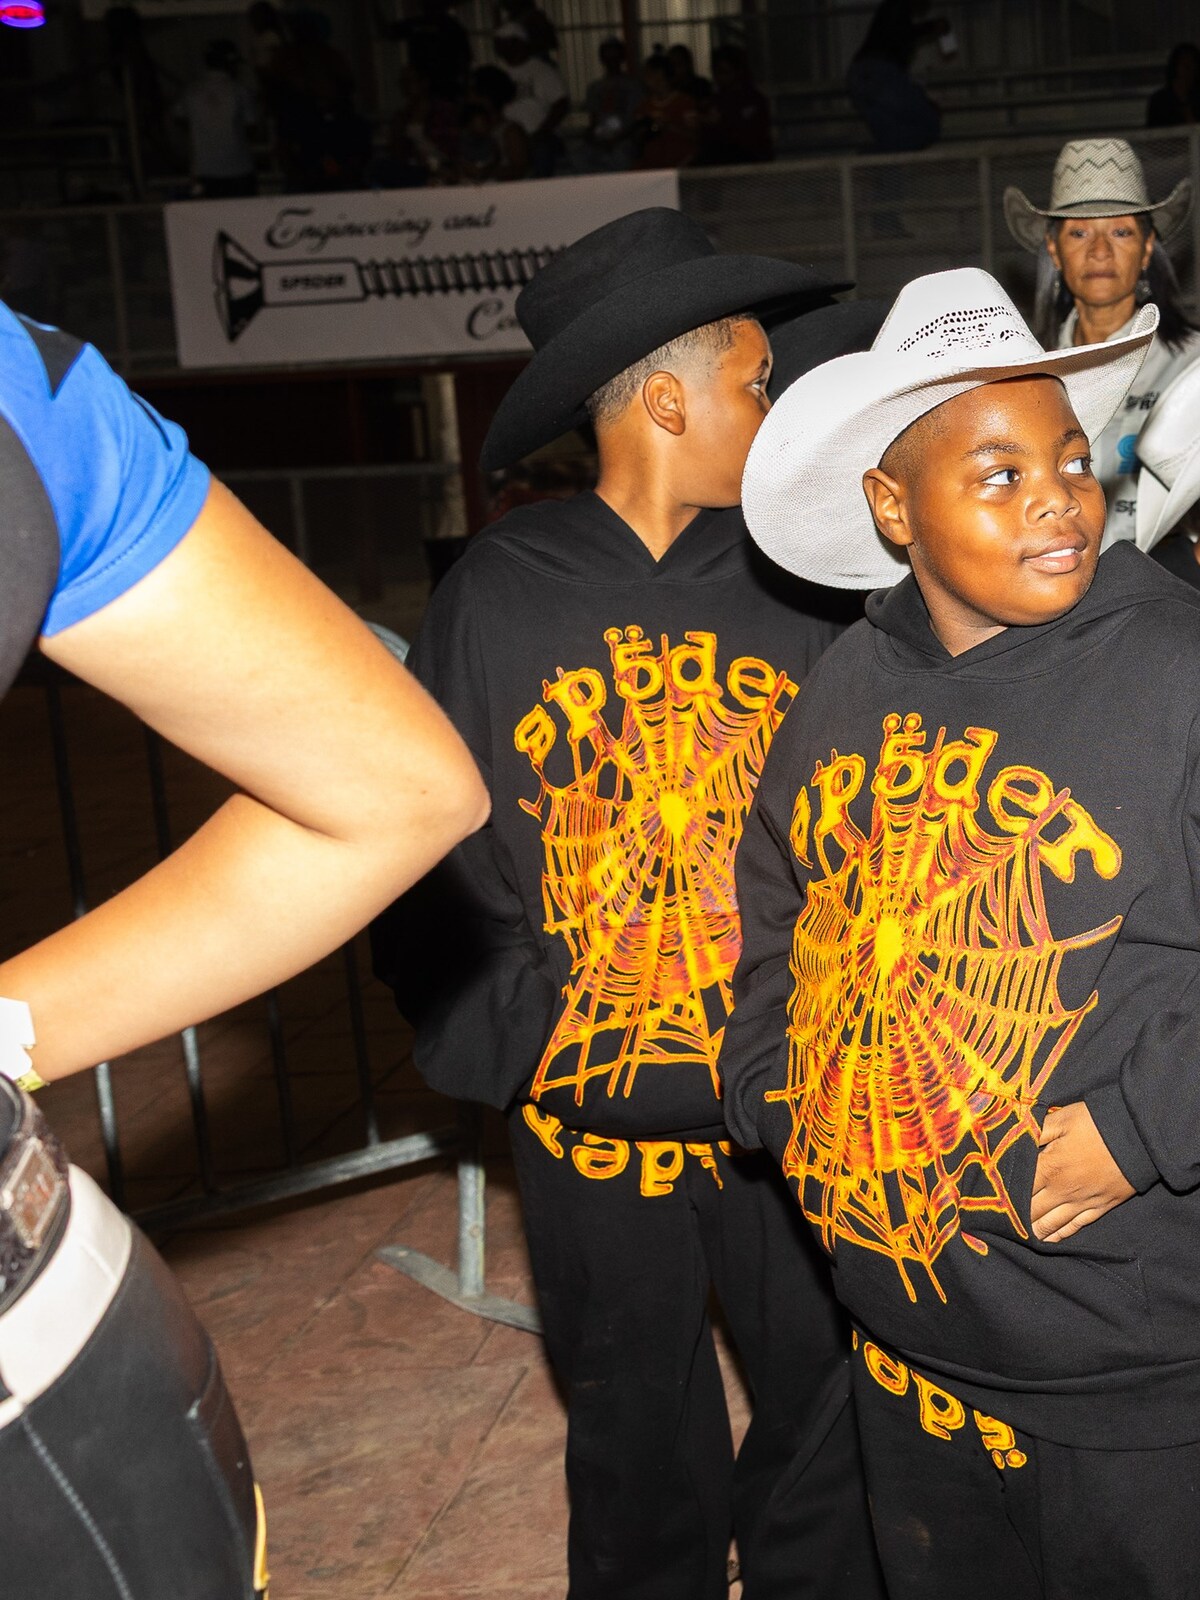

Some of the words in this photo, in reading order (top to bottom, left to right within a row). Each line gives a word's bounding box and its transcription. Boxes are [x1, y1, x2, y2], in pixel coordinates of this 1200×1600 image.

[265, 207, 432, 253] Engineering
[443, 204, 496, 231] and
[514, 624, 799, 766] sp5de
